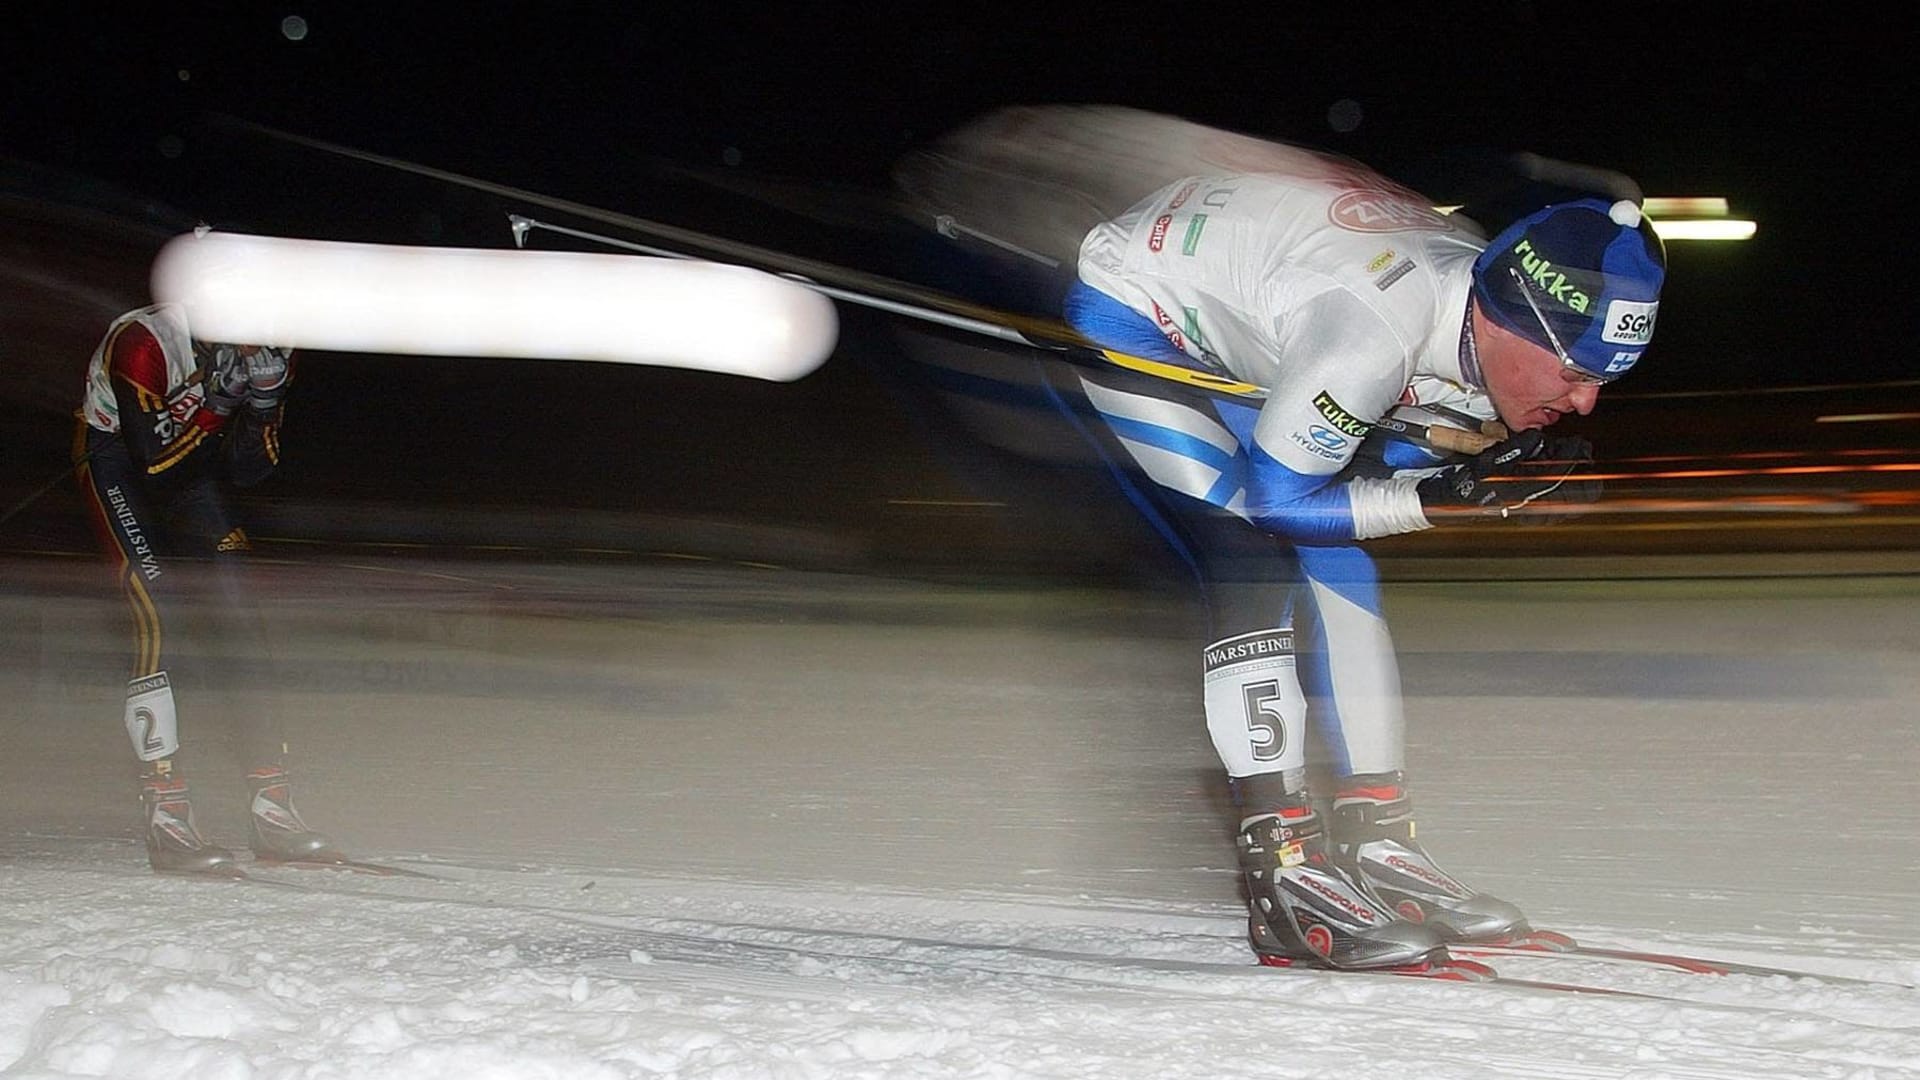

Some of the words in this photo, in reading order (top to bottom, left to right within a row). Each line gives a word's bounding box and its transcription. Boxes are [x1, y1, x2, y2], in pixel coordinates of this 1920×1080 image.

[1514, 240, 1590, 314] rukka
[1315, 396, 1369, 436] rukka
[106, 485, 162, 580] WARSTEINER
[135, 706, 165, 755] 2
[1241, 679, 1287, 762] 5
